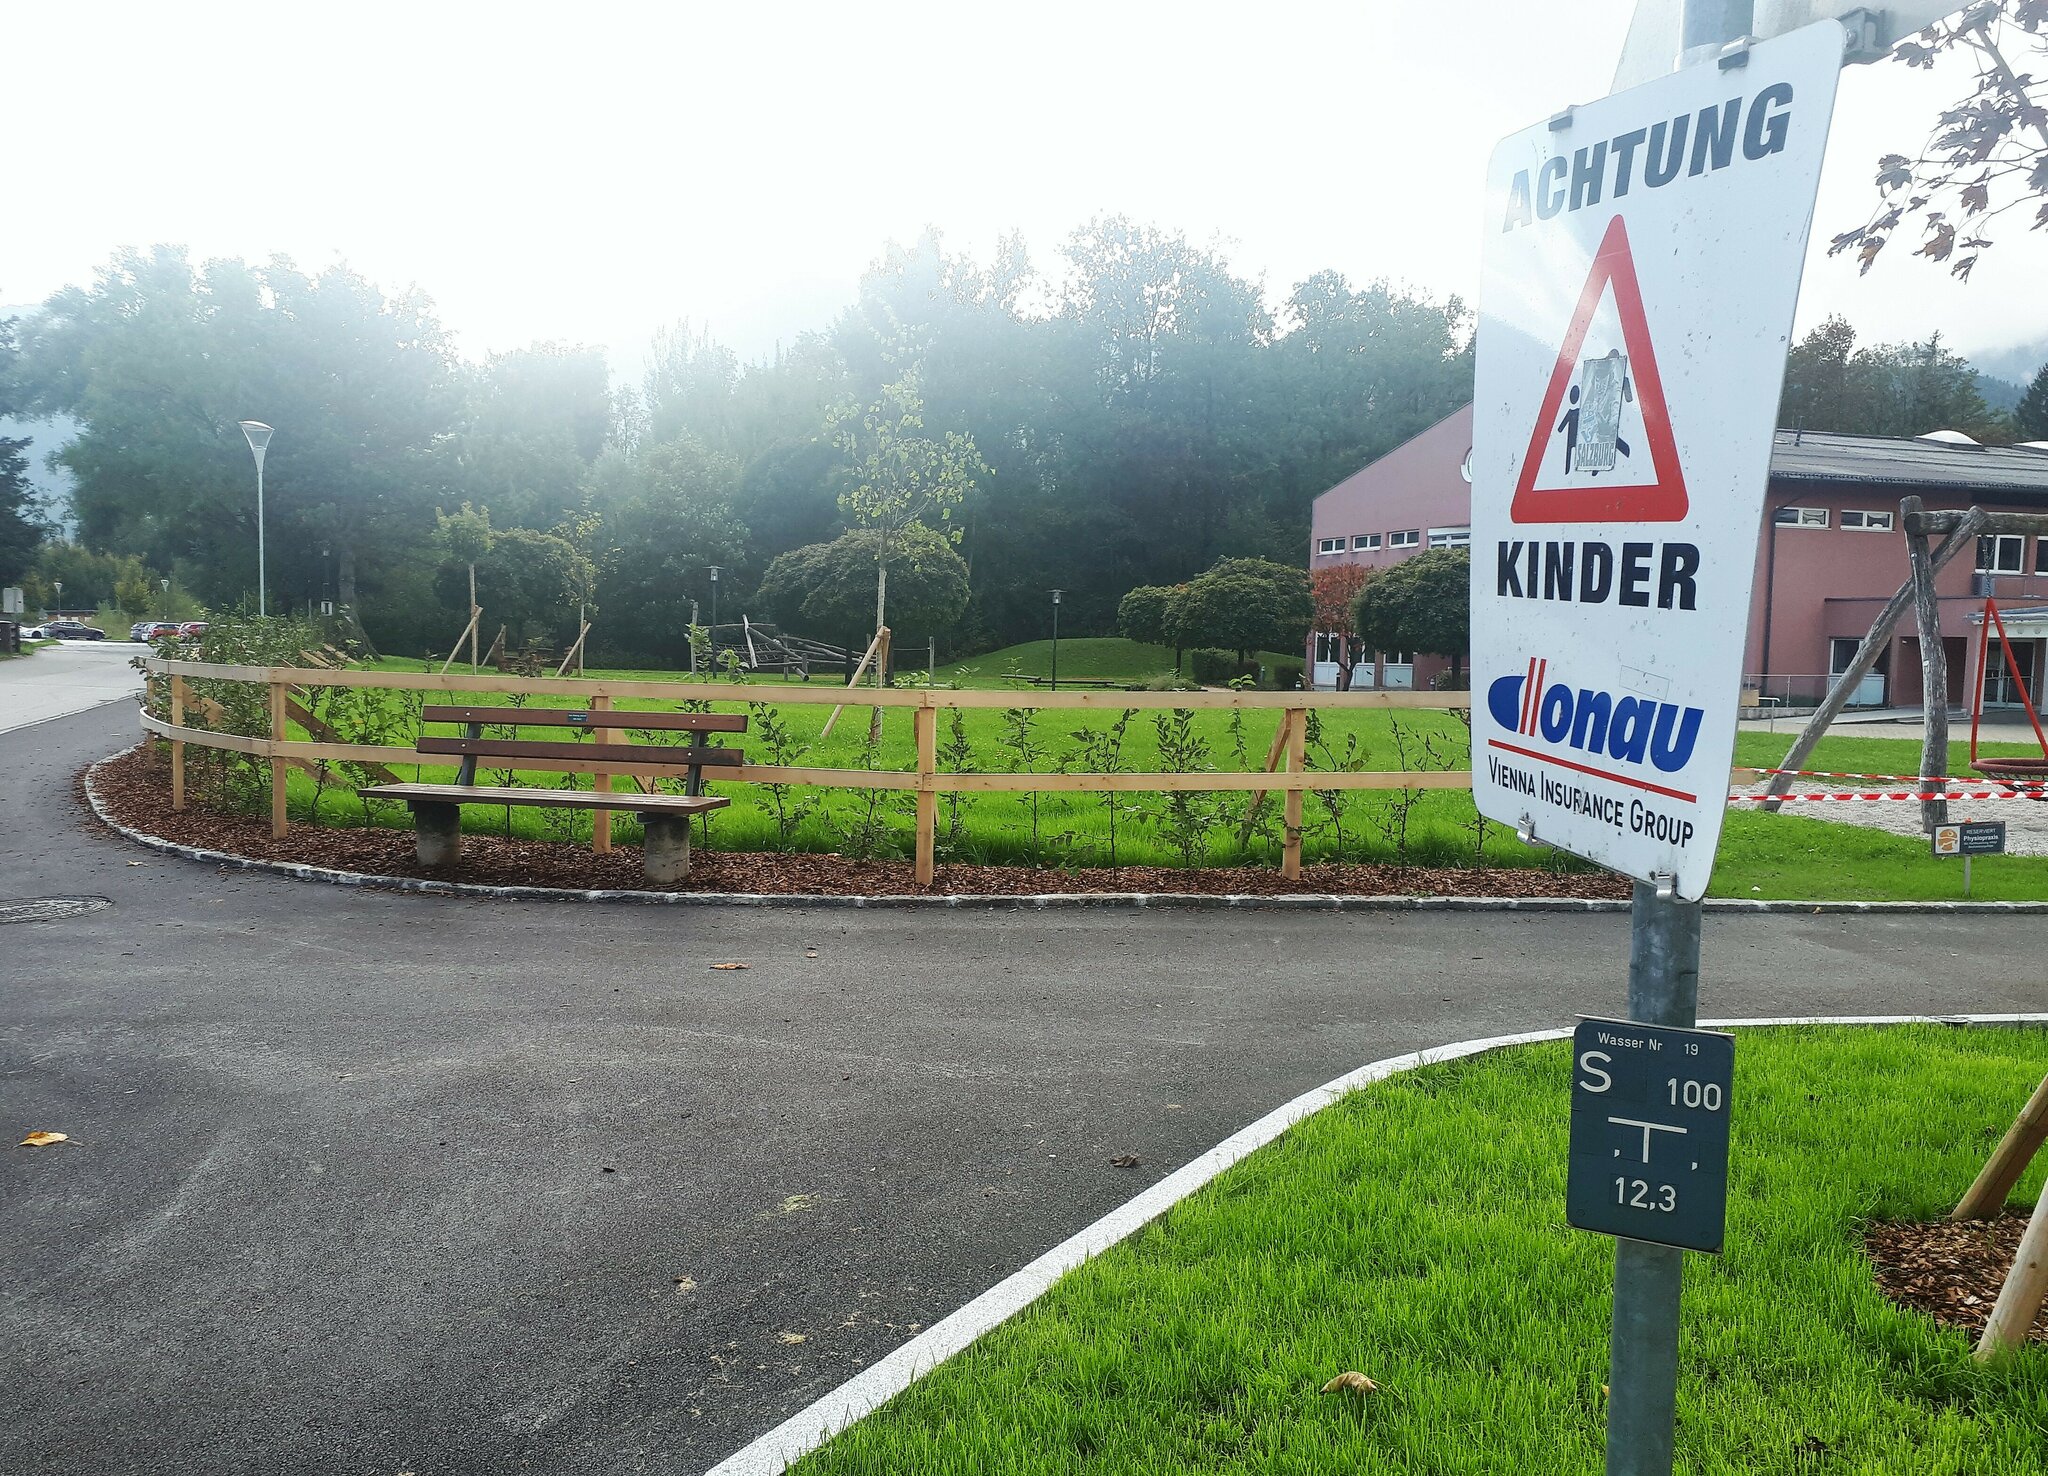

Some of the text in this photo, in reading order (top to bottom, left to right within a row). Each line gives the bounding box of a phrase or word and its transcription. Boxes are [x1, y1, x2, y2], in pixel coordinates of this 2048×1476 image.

[1503, 82, 1794, 233] ACHTUNG
[1497, 541, 1700, 611] KINDER
[1488, 754, 1536, 798] VIENNA
[1629, 799, 1693, 848] GROUP
[1597, 1032, 1699, 1056] Wasser Nr 19
[1579, 1051, 1612, 1093] S
[1667, 1078, 1722, 1111] 100
[1615, 1177, 1676, 1211] 12,3
